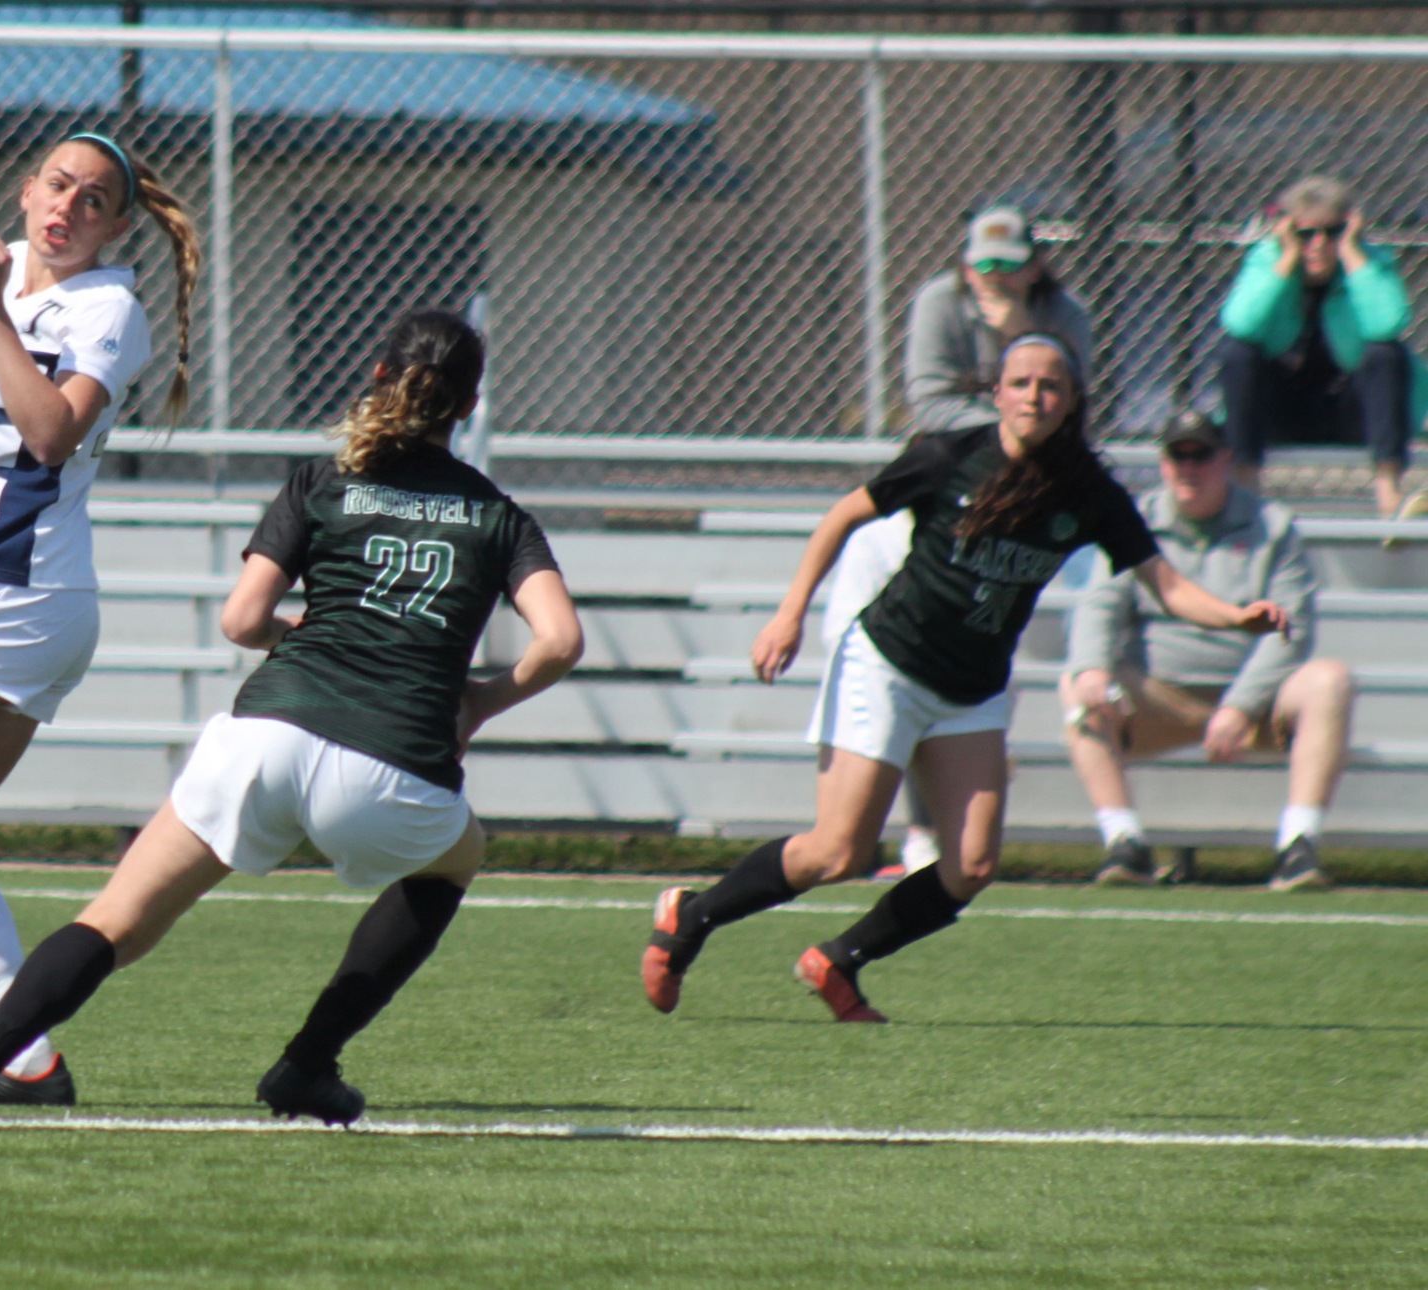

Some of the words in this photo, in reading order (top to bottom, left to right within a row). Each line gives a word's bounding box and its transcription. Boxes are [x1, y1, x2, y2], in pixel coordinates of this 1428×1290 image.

[21, 299, 64, 341] T
[343, 484, 483, 526] ROOSEVELT
[360, 535, 455, 629] 22
